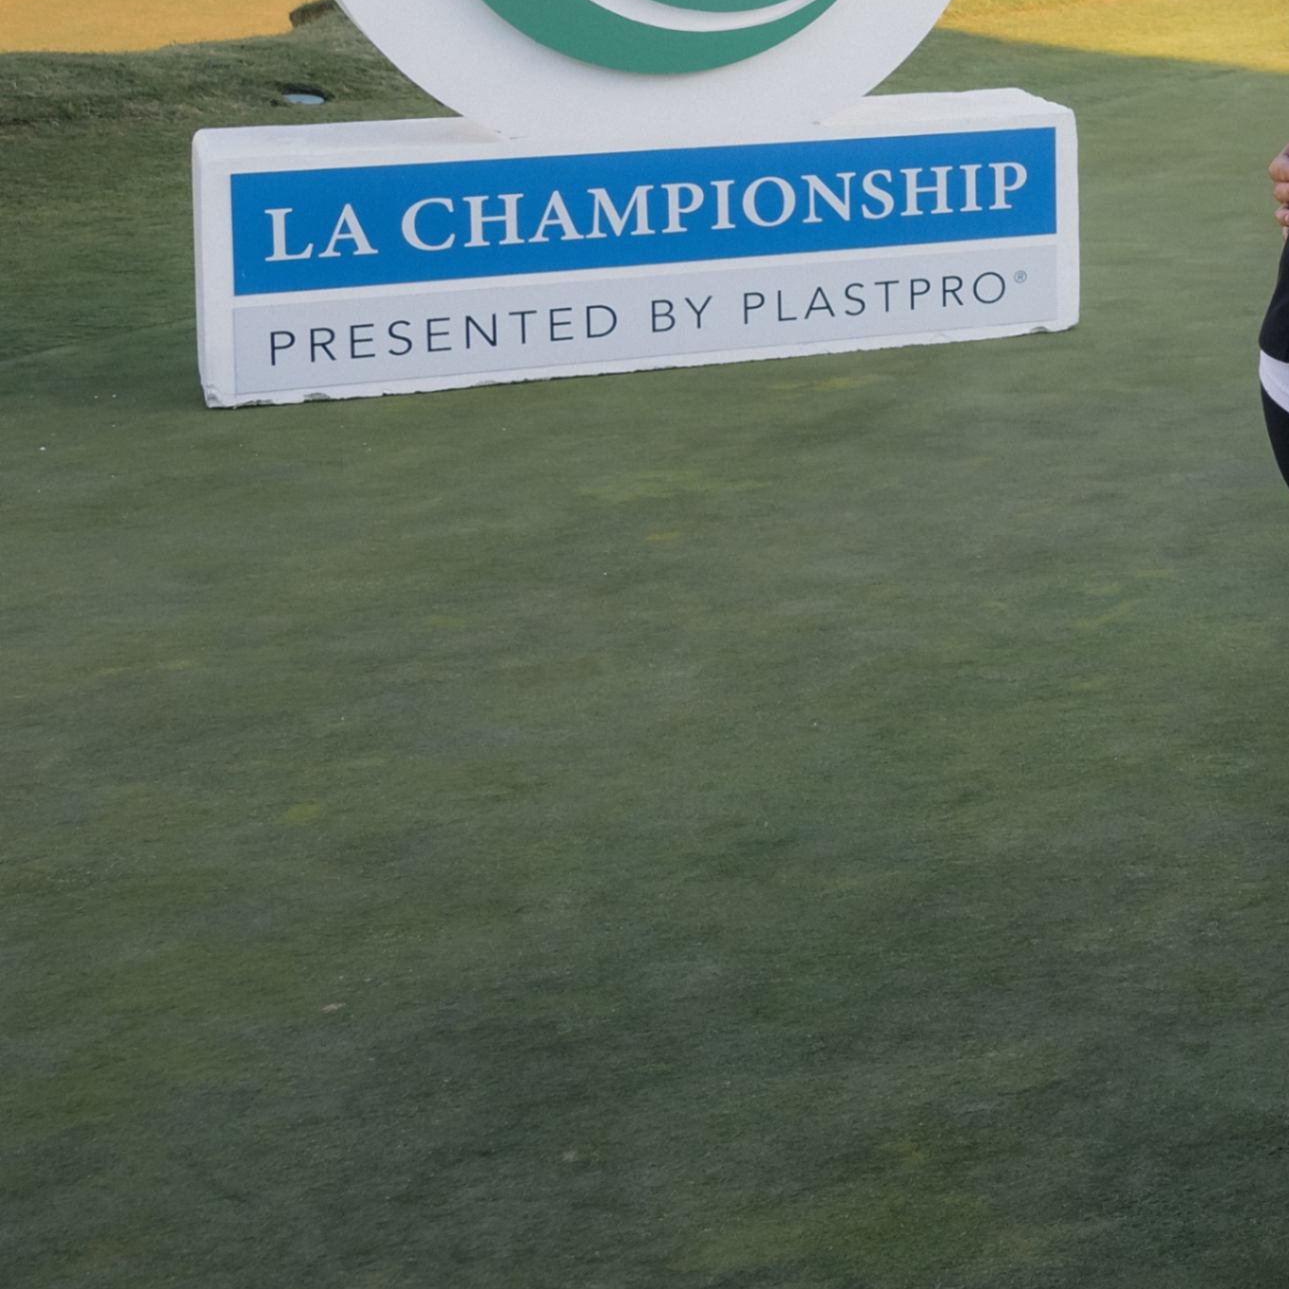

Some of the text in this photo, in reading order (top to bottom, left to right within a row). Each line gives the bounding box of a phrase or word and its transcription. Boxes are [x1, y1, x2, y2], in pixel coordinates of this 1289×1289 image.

[265, 162, 1030, 262] LA CHAMPIONSHIP
[270, 304, 619, 366] PRESENTED
[651, 295, 712, 333] BY
